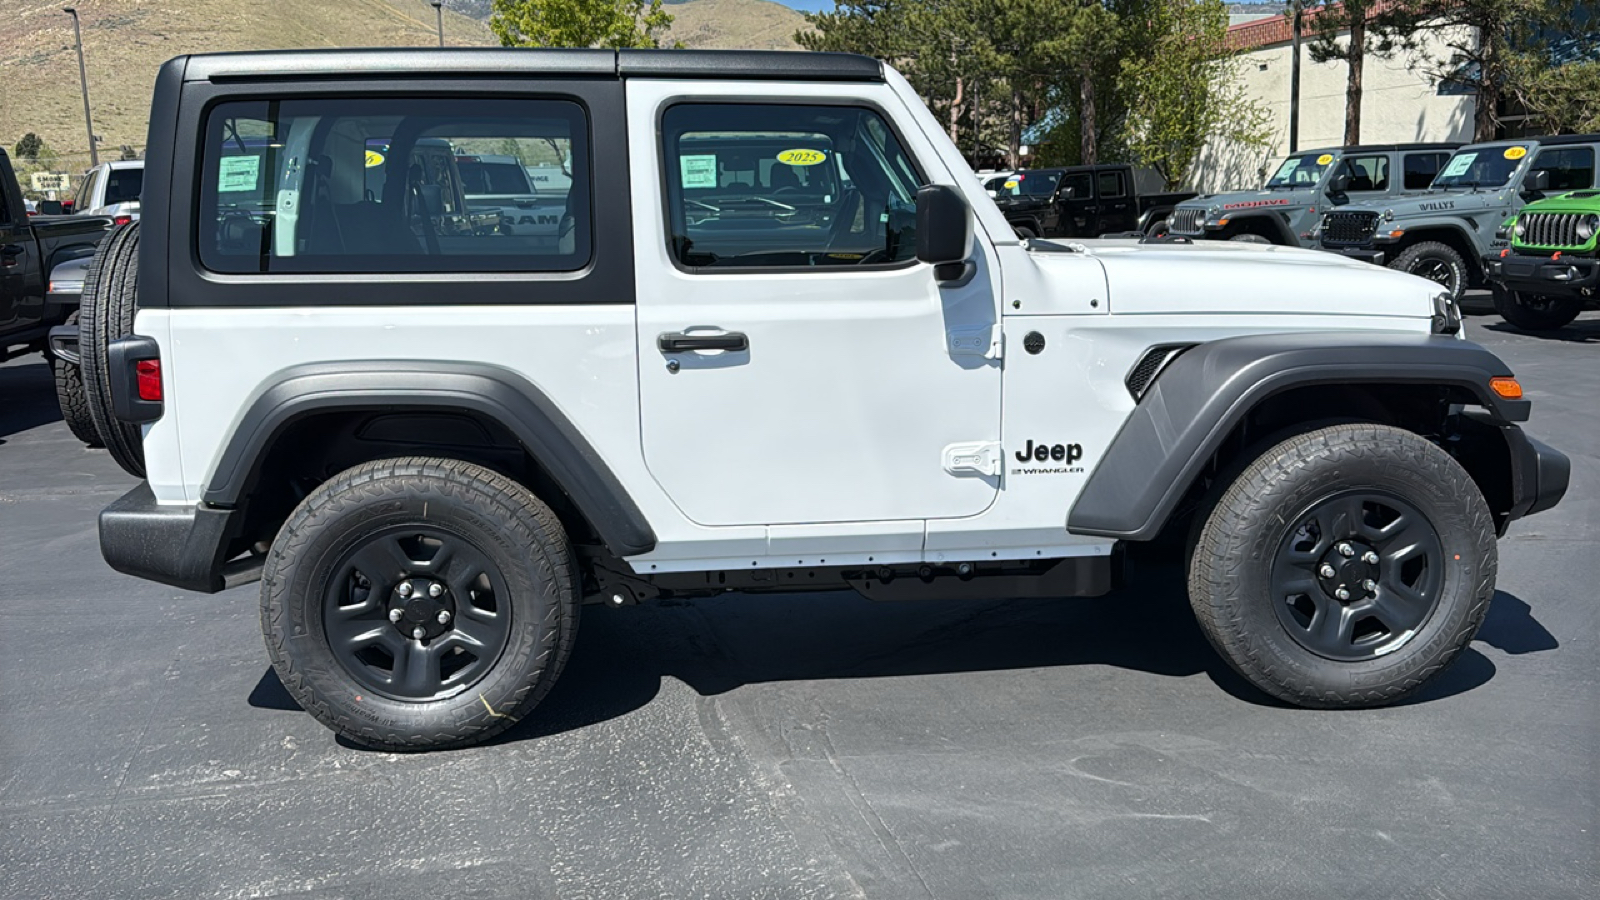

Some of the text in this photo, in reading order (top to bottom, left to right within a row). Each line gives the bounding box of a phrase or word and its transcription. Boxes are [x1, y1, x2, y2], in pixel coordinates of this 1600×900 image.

[786, 152, 818, 162] 2025
[1224, 199, 1290, 210] MOJAVE
[1419, 200, 1455, 211] WILLYS
[1489, 240, 1509, 249] Jeep
[1015, 440, 1083, 465] Jeep
